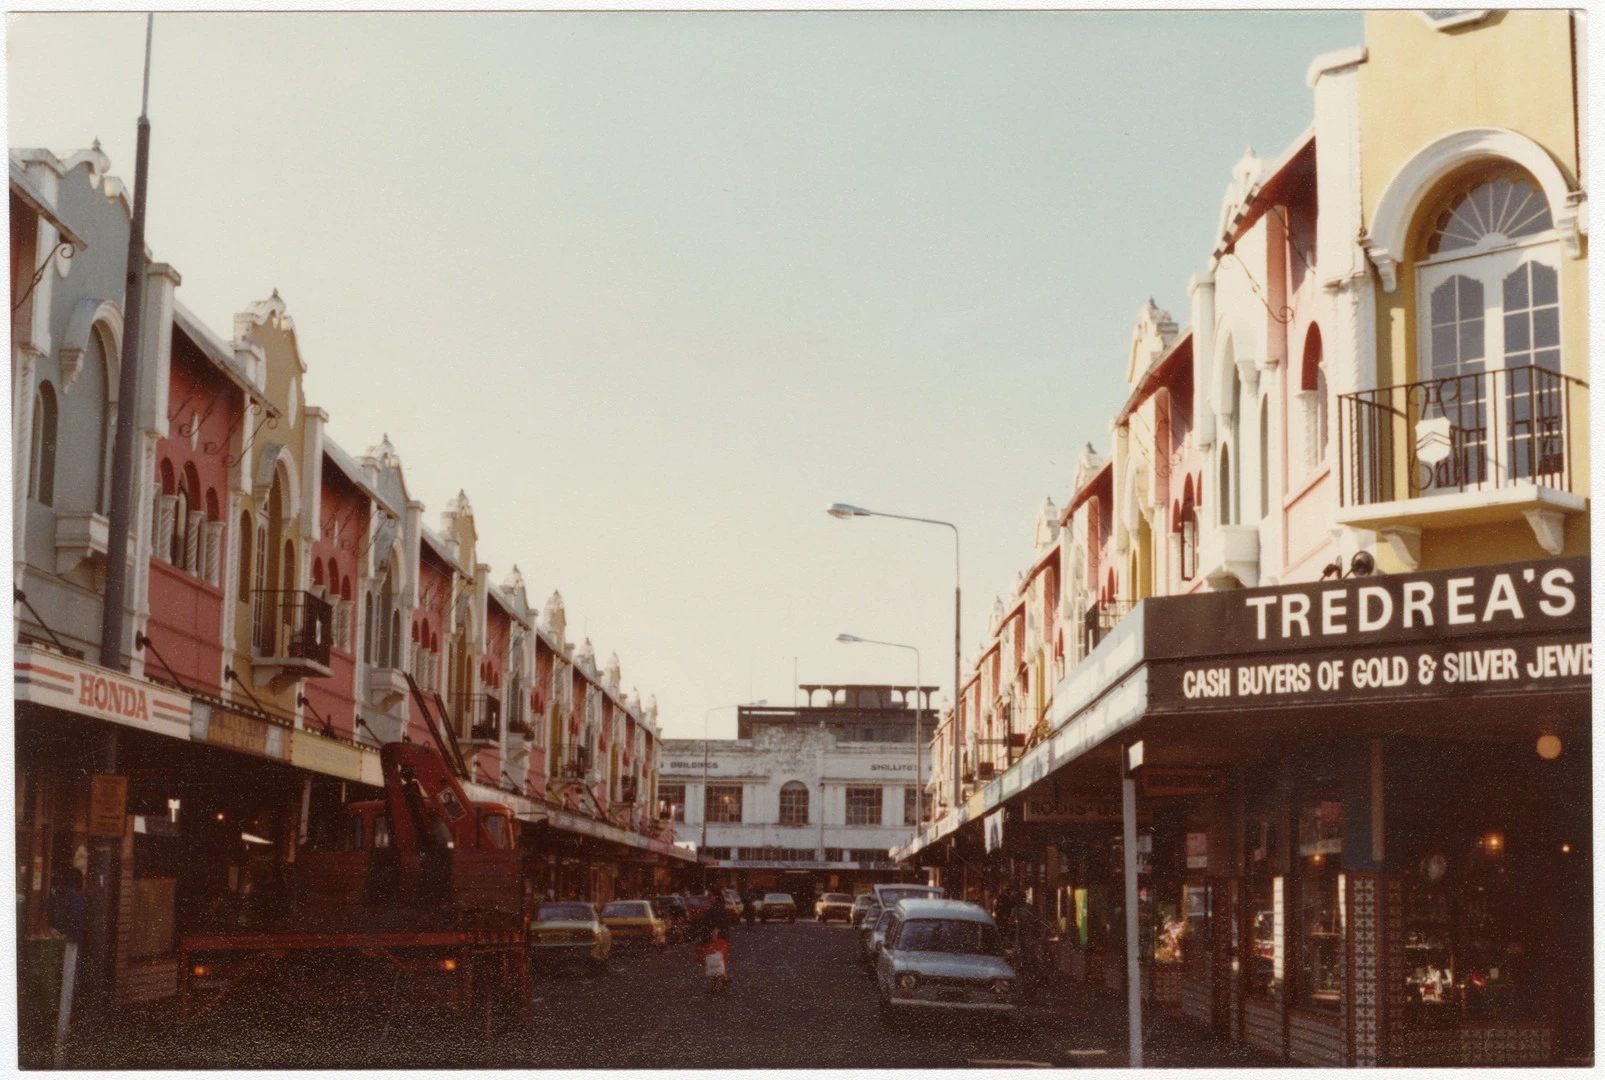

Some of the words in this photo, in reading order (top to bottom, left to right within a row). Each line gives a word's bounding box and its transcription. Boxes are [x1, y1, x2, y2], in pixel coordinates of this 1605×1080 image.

[1246, 568, 1576, 640] TREDREA'S
[79, 672, 148, 720] HONDA
[1183, 667, 1230, 698] CASH
[1238, 662, 1311, 695] BUYERS
[1318, 660, 1344, 690] OF
[1352, 655, 1408, 688] GOLD
[1418, 653, 1438, 685] &
[1443, 648, 1518, 682] SILVER
[1526, 643, 1592, 678] JEWE
